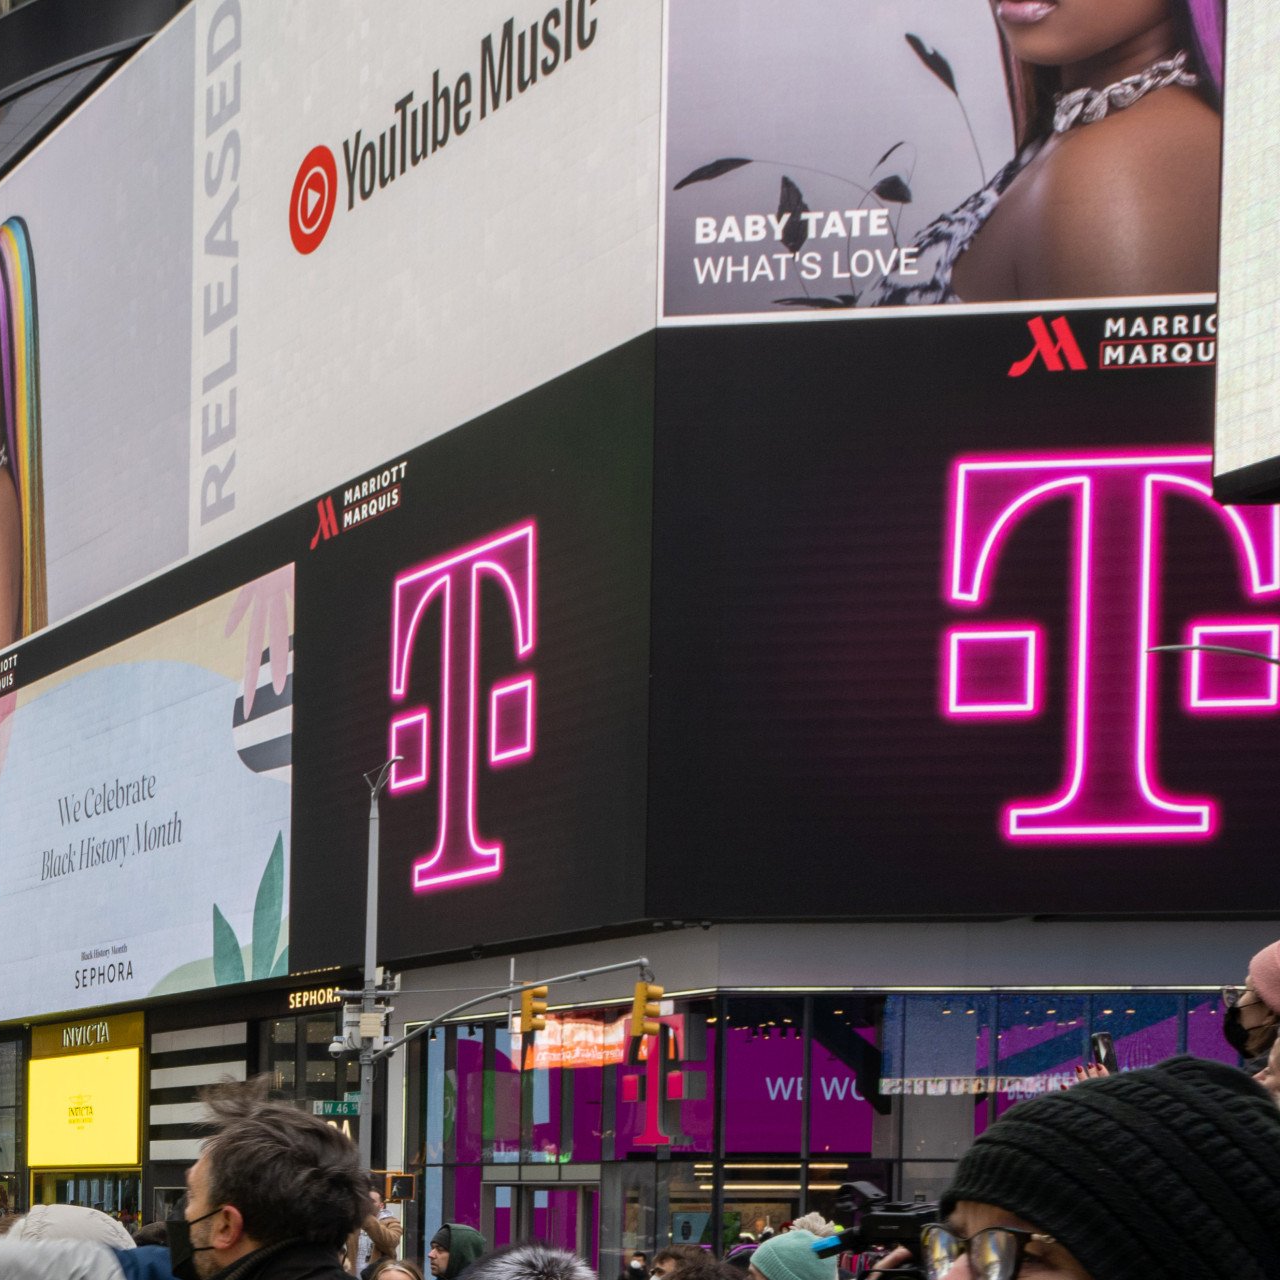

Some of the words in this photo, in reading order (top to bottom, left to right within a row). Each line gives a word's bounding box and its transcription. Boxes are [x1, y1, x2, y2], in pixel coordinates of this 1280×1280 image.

[342, 68, 473, 212] YouTube
[478, 0, 598, 121] Music
[694, 213, 790, 245] BABY
[800, 208, 890, 240] TATE
[201, 0, 240, 526] RELEASED
[693, 252, 822, 285] WHAT'S
[831, 247, 920, 280] LOVE
[1104, 313, 1217, 338] MARRIO
[1104, 341, 1216, 366] MARQU
[344, 461, 408, 506] MARRIOTT
[344, 488, 399, 528] MARQUIS
[57, 795, 81, 827] We
[84, 774, 157, 820] Celebrate
[41, 843, 76, 881] Black
[79, 833, 130, 870] History
[132, 810, 183, 857] Month
[75, 960, 134, 990] SEPHORA
[289, 986, 341, 1009] SEPHORA
[63, 1021, 110, 1048] INVICTA
[324, 1103, 333, 1113] W
[336, 1103, 348, 1114] 46
